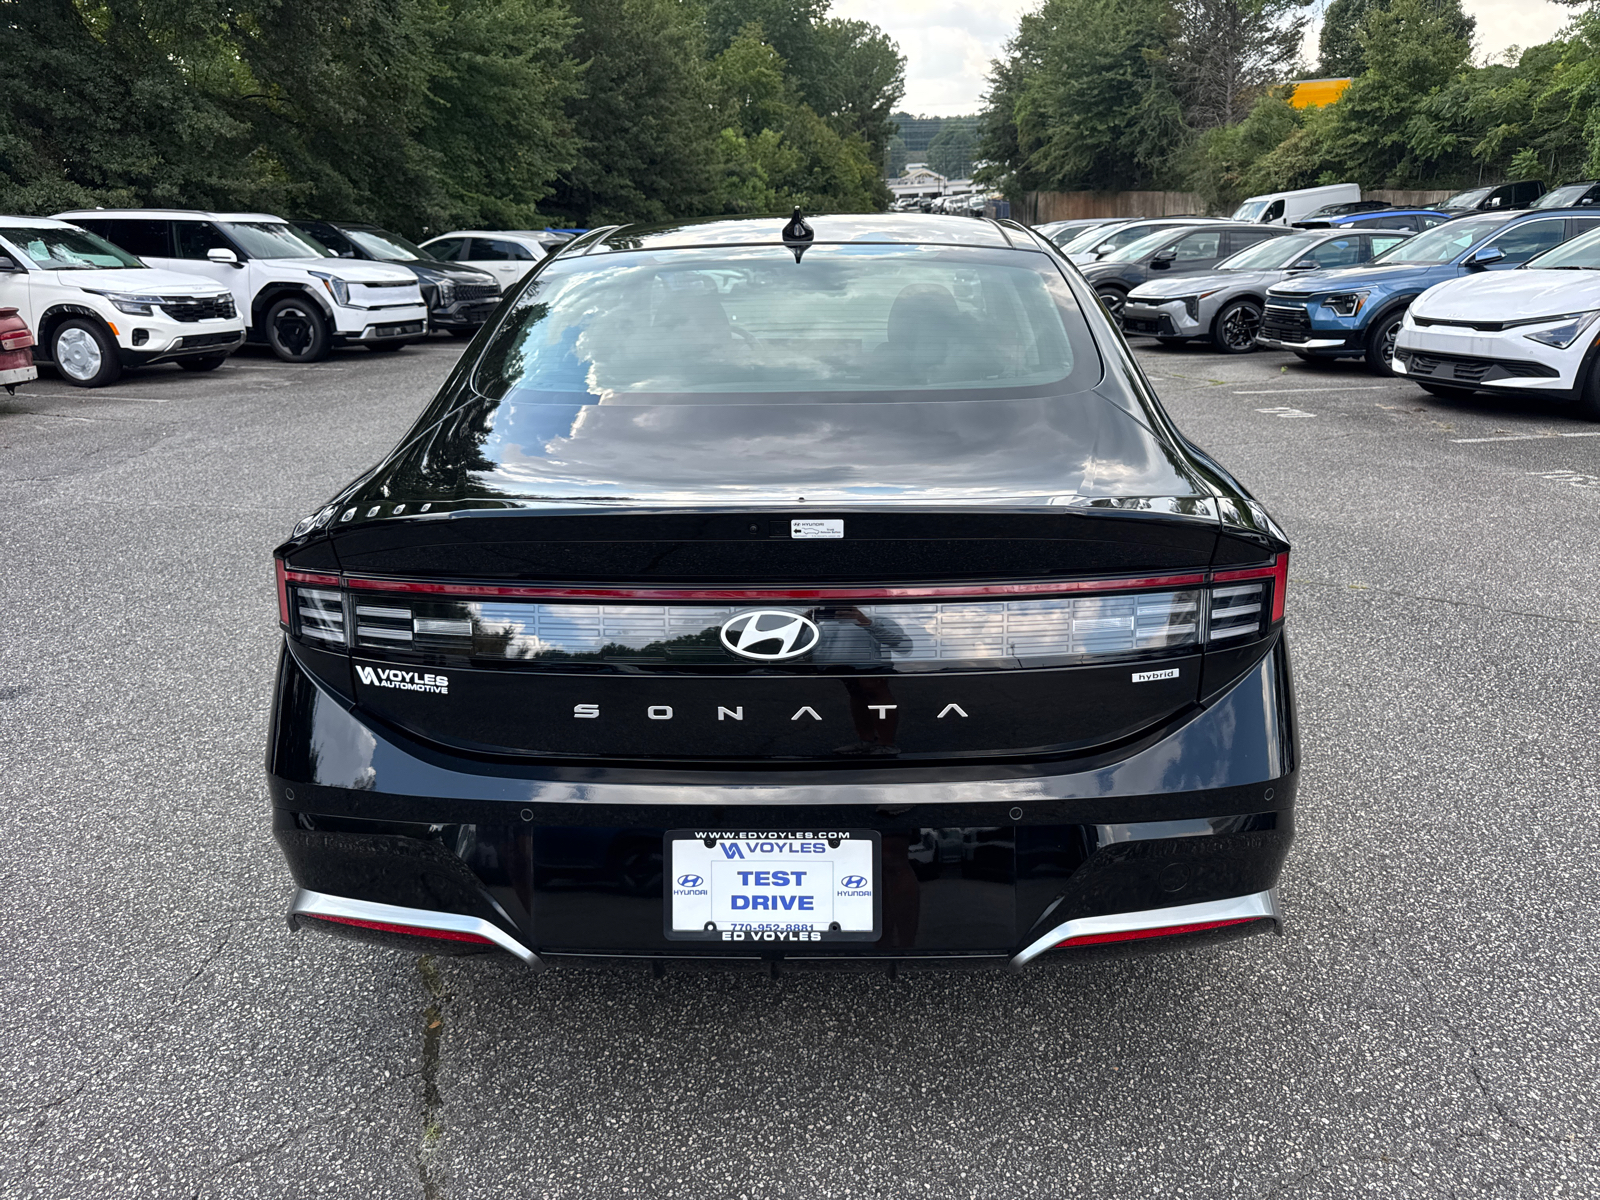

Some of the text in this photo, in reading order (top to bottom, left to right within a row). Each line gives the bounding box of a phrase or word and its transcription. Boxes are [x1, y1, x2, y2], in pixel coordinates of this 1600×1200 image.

[377, 668, 449, 687] VOYLES
[1138, 670, 1174, 681] hybrid
[380, 680, 449, 694] AUTOMOTIVE
[573, 703, 969, 721] SONATA
[694, 831, 851, 839] WWW.EDVOYLES.COM
[745, 842, 826, 854] VOYLES
[737, 870, 807, 886] TEST
[731, 895, 814, 911] DRIVE
[730, 923, 814, 931] 770-952-8881
[722, 932, 822, 941] ED VOYLES
